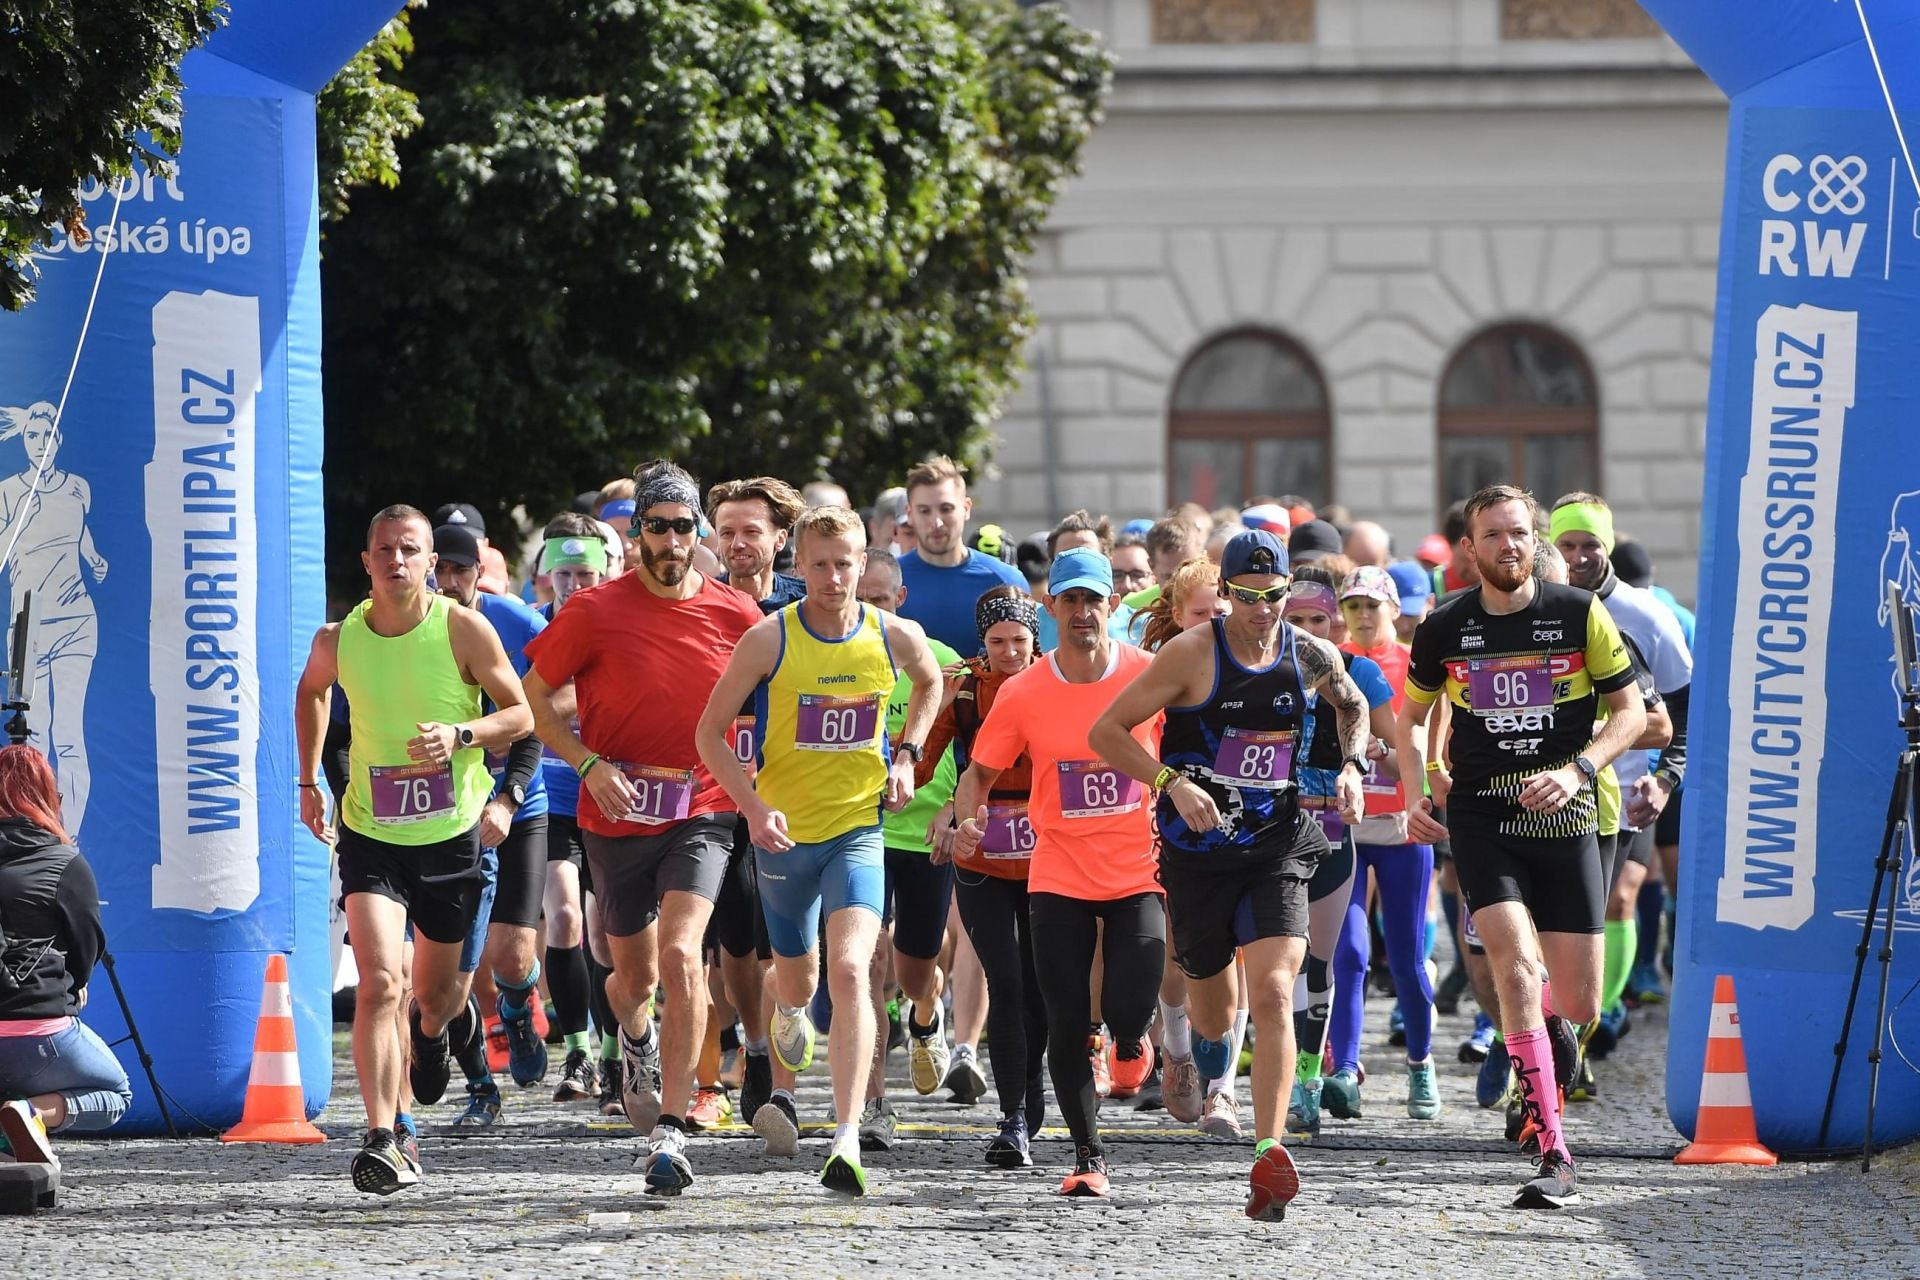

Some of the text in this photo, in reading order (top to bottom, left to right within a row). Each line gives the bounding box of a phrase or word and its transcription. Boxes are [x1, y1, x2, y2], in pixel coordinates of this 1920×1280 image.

[1758, 219, 1868, 278] RW
[181, 368, 241, 835] WWW.SPORTLIPA.CZ
[1743, 331, 1825, 899] WWW.CITYCROSSRUN.CZ
[1461, 640, 1485, 649] INVENT
[817, 673, 857, 685] newline
[1493, 671, 1529, 706] 96
[821, 708, 857, 742] 60
[737, 729, 753, 761] 0
[1497, 738, 1544, 751] CST
[1240, 745, 1275, 779] 83
[393, 778, 431, 815] 76
[632, 778, 663, 815] 91
[1083, 772, 1119, 807] 63
[1005, 816, 1035, 850] 13
